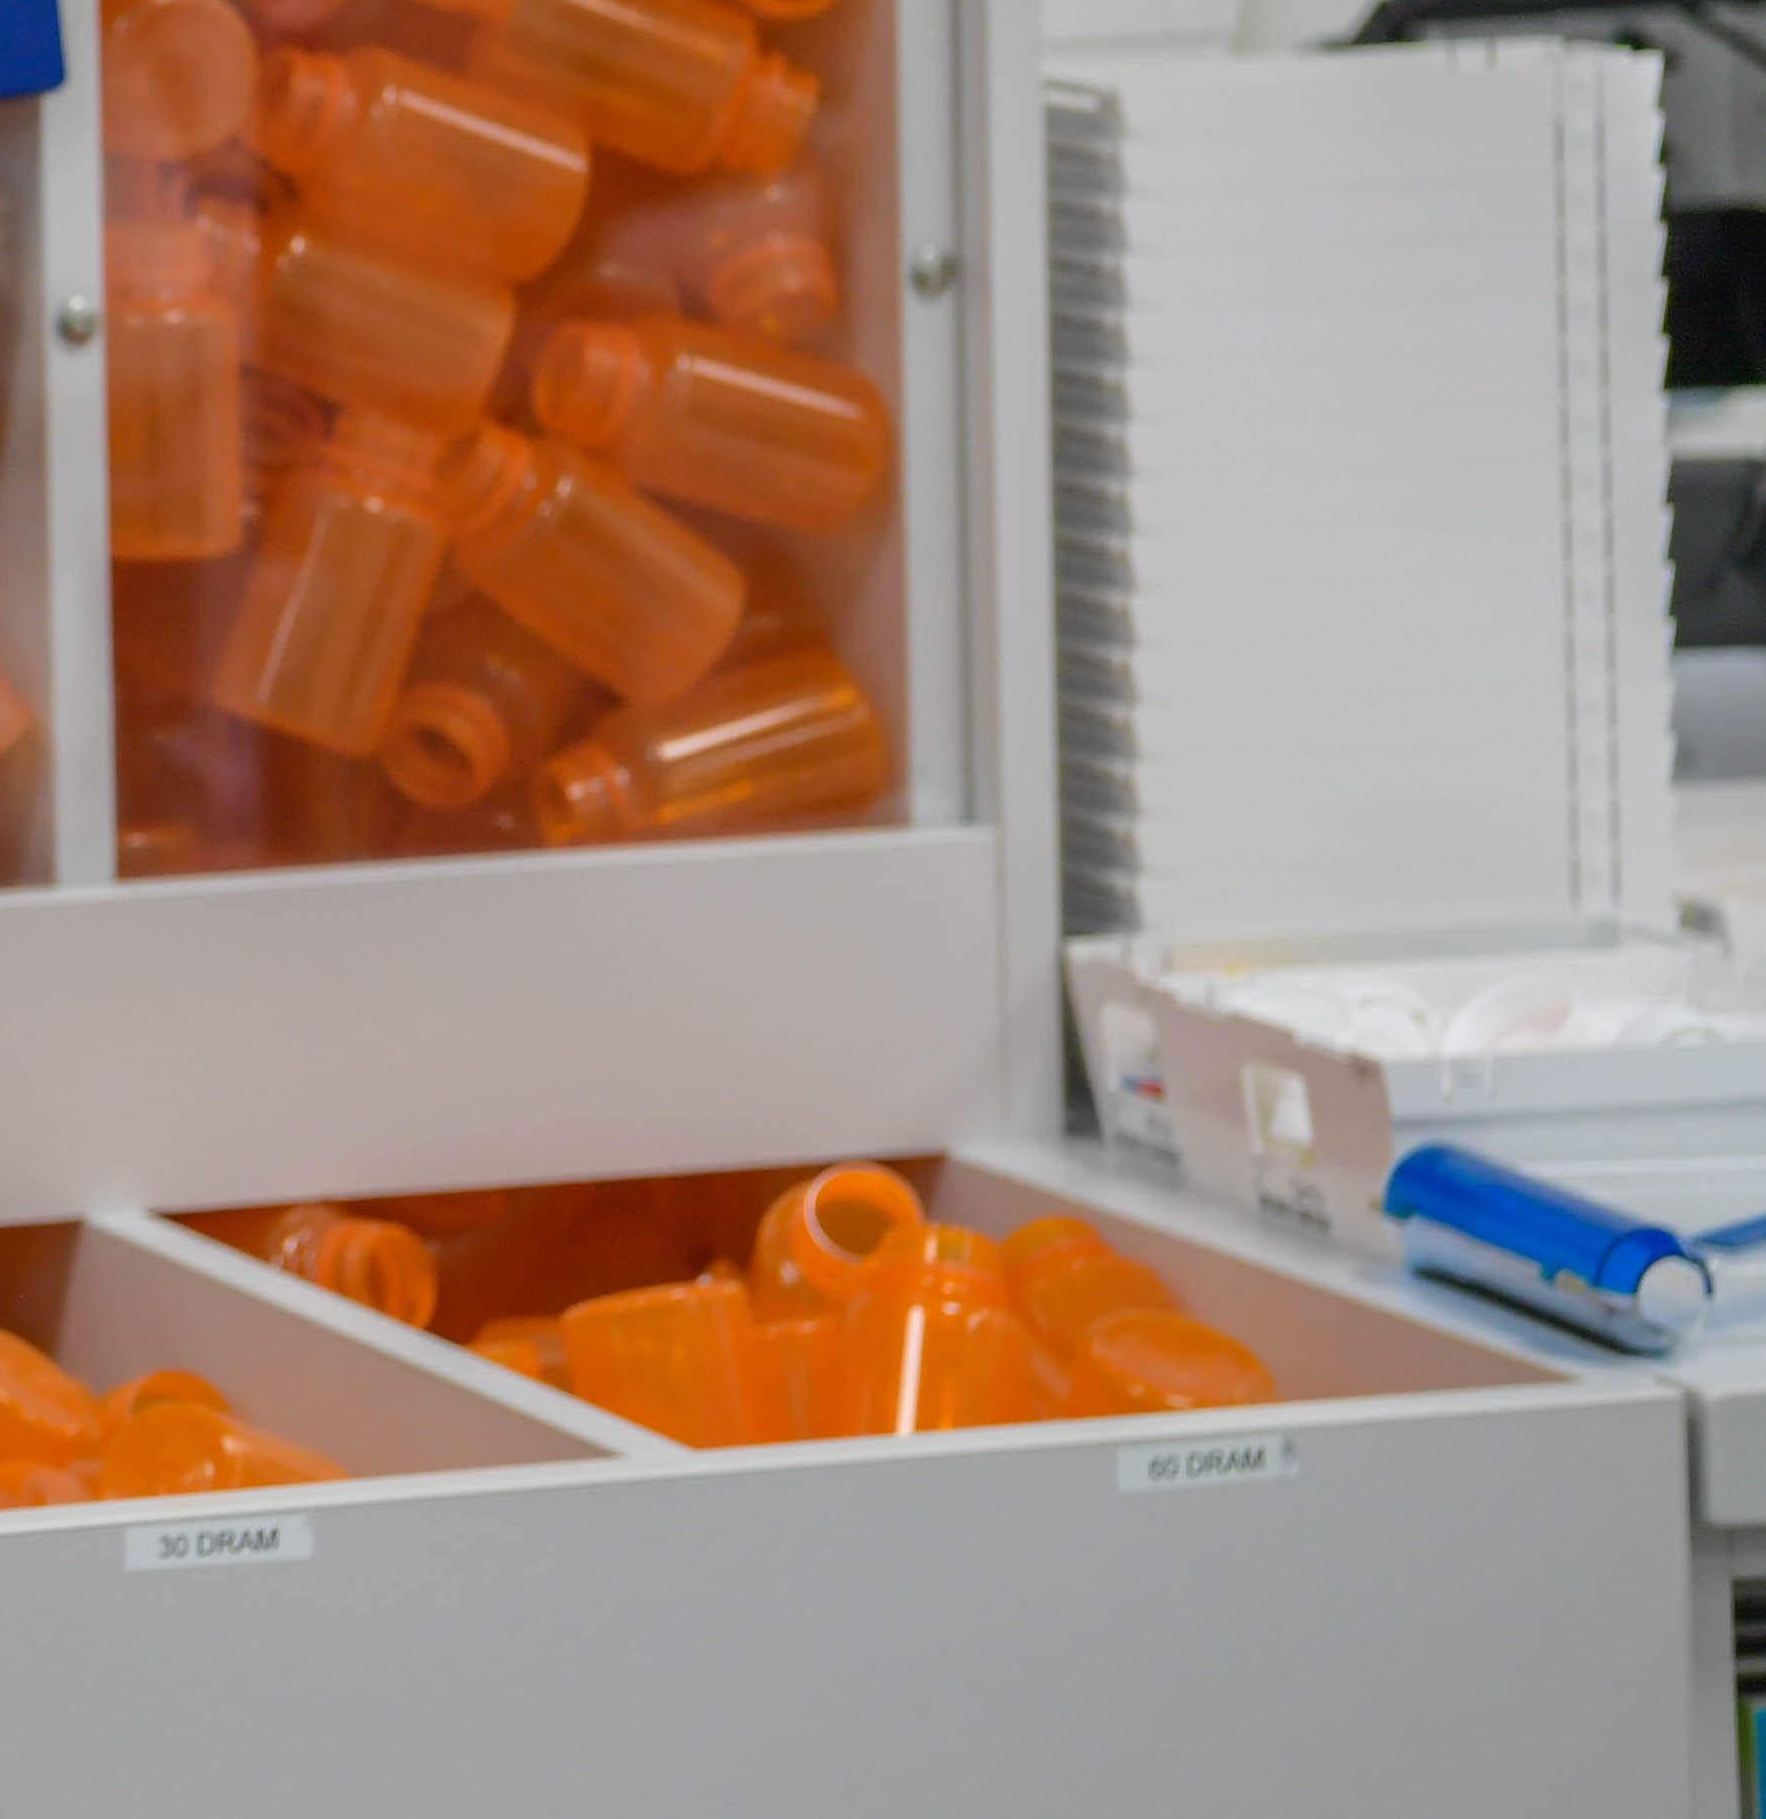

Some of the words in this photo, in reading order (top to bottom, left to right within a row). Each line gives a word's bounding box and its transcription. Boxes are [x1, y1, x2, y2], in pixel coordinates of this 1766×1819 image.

[1186, 1446, 1266, 1478] DRAM
[158, 1534, 191, 1560] 30
[196, 1527, 280, 1557] DRAM
